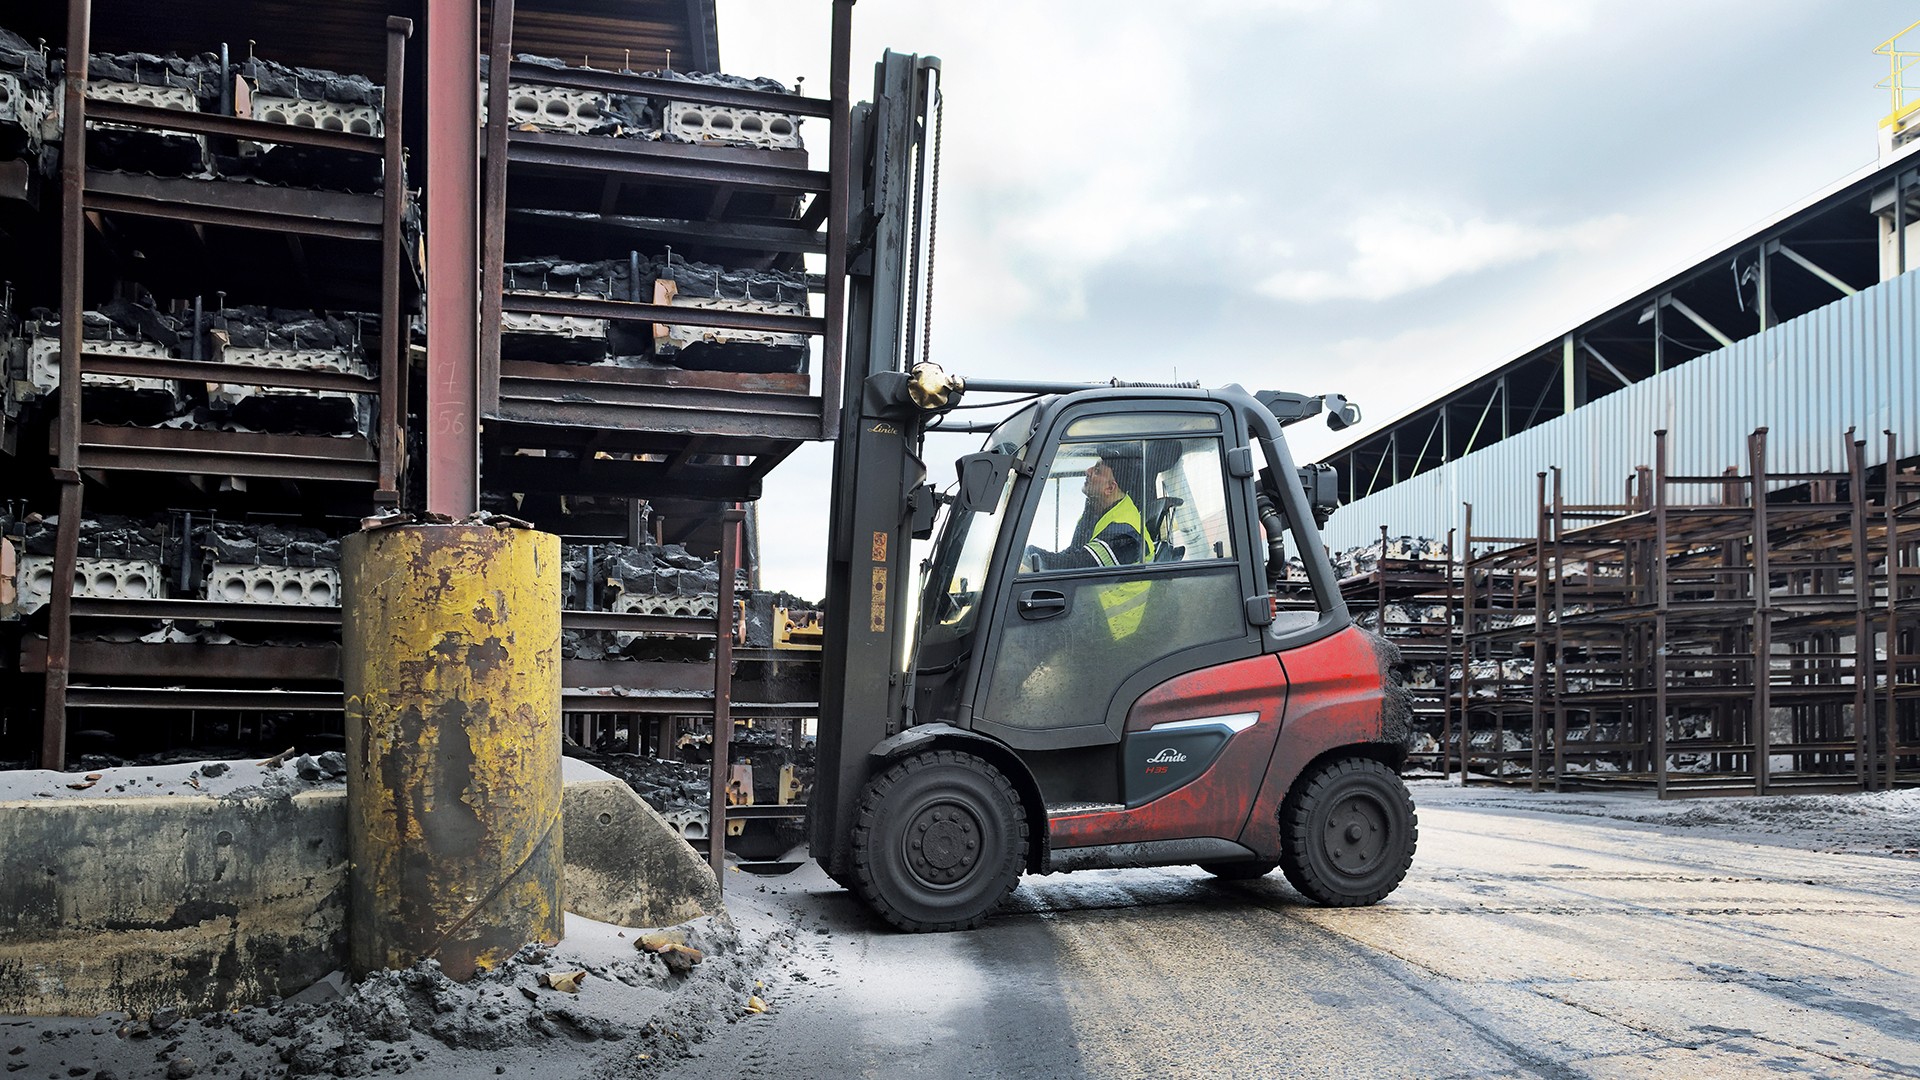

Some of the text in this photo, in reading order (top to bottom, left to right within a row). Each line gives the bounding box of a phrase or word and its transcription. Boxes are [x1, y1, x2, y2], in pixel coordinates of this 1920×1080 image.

[438, 360, 456, 394] 7
[438, 409, 465, 435] 56
[867, 423, 898, 435] Linde
[1146, 747, 1187, 763] Linde
[1145, 766, 1169, 774] H35
